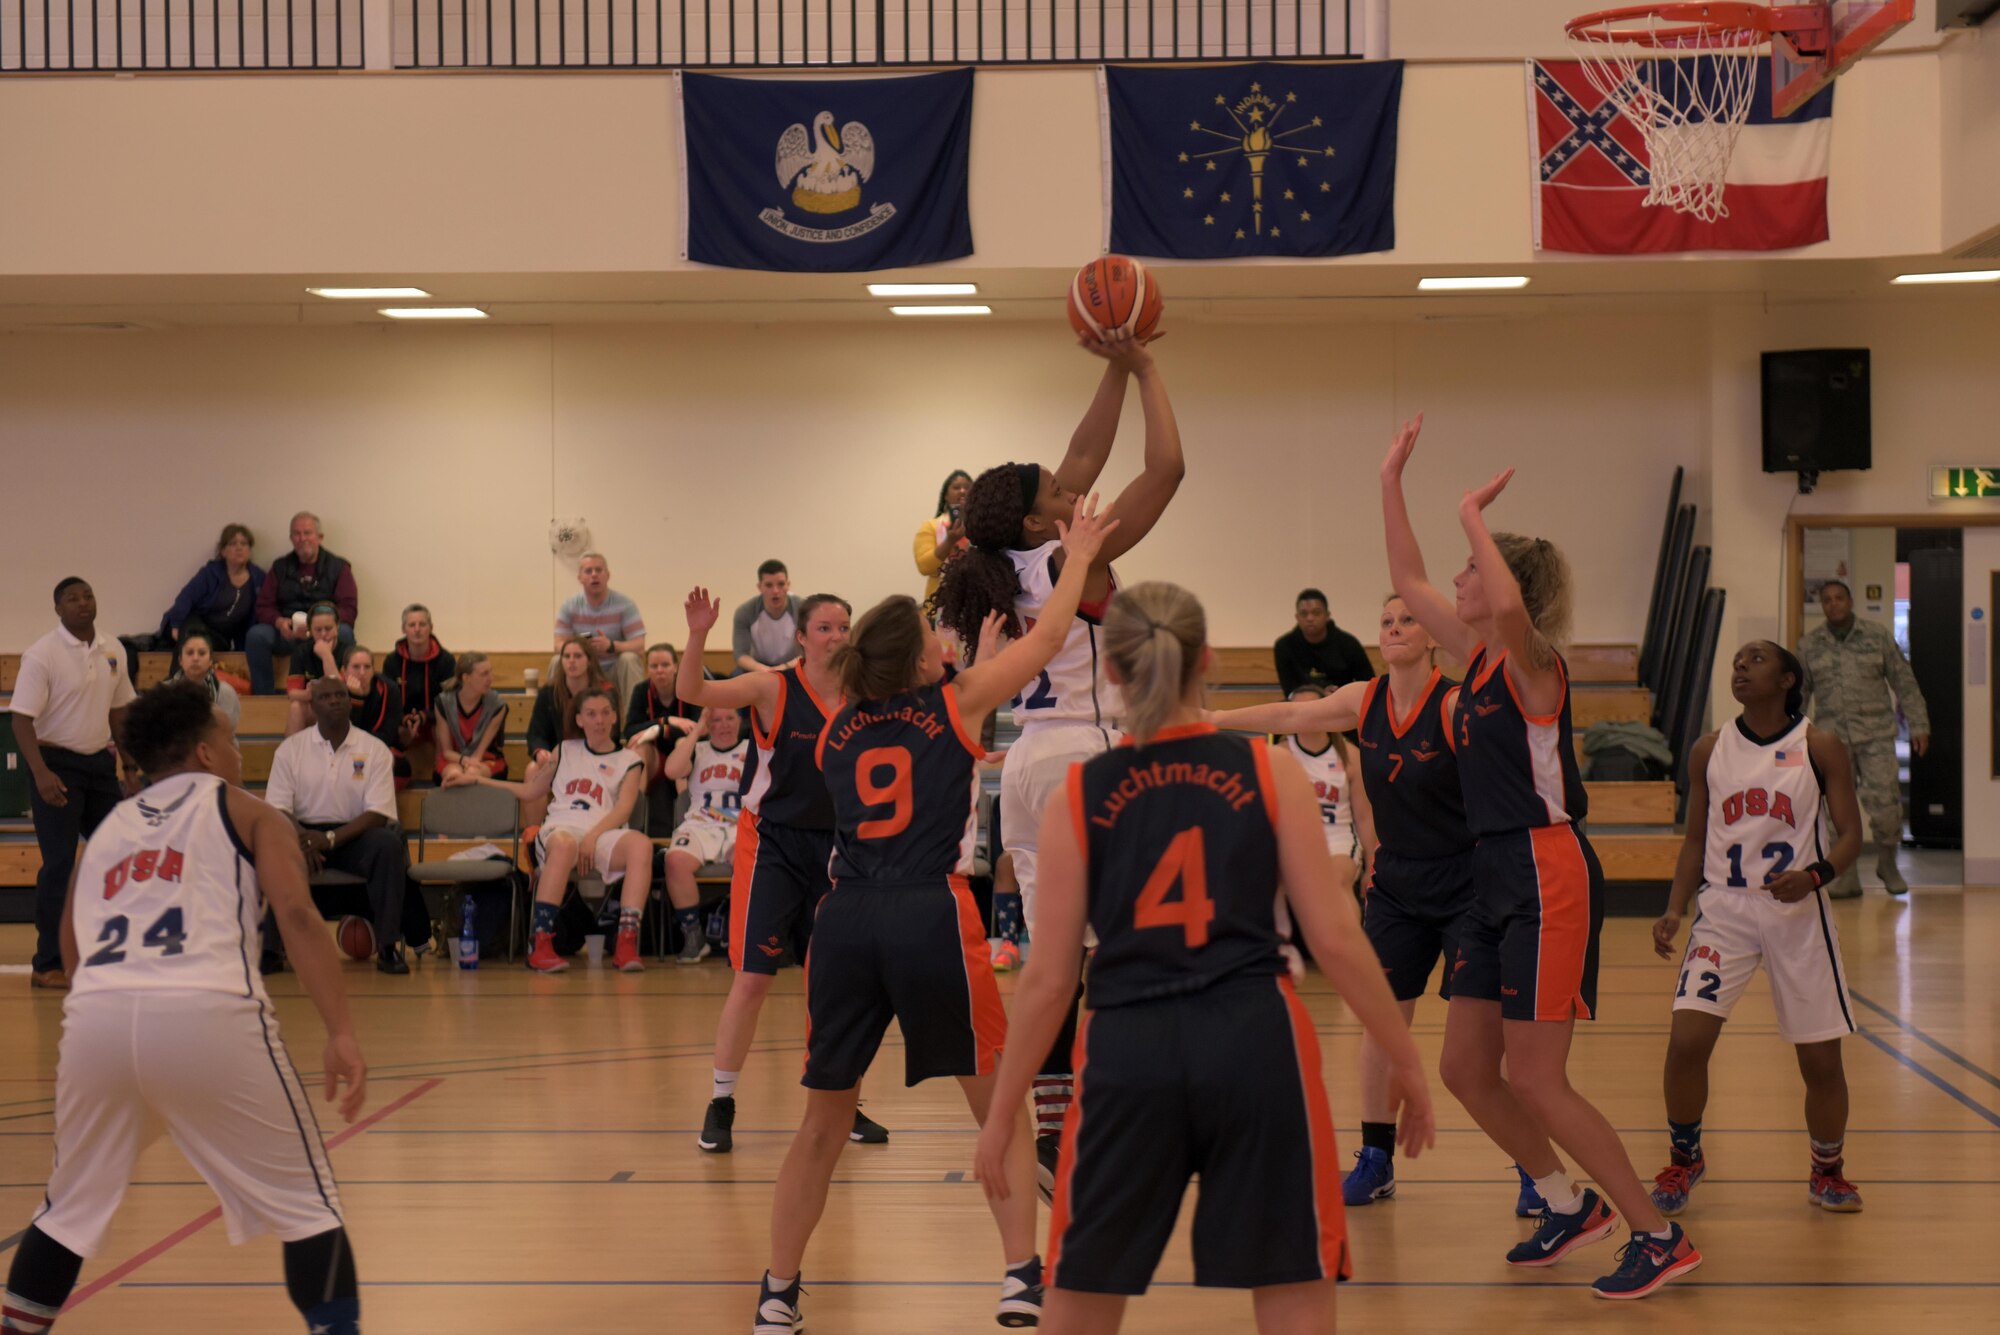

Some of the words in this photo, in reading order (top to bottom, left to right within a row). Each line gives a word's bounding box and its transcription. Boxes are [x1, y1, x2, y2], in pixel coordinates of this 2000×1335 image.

[1233, 93, 1277, 114] INDIANA
[789, 226, 823, 240] JUSTICE
[825, 230, 843, 240] AND
[844, 207, 893, 238] CONFIDENCE
[700, 764, 741, 784] USA
[1388, 753, 1404, 783] 7
[565, 778, 603, 807] USA
[855, 745, 914, 841] 9
[1091, 761, 1257, 829] Luchtmacht
[1313, 781, 1340, 803] SA
[1722, 788, 1796, 830] USA
[103, 846, 184, 901] USA
[1727, 842, 1794, 887] 12
[1133, 825, 1216, 948] 4
[84, 907, 187, 967] 24
[1687, 946, 1721, 970] USA
[1677, 970, 1721, 1003] 12
